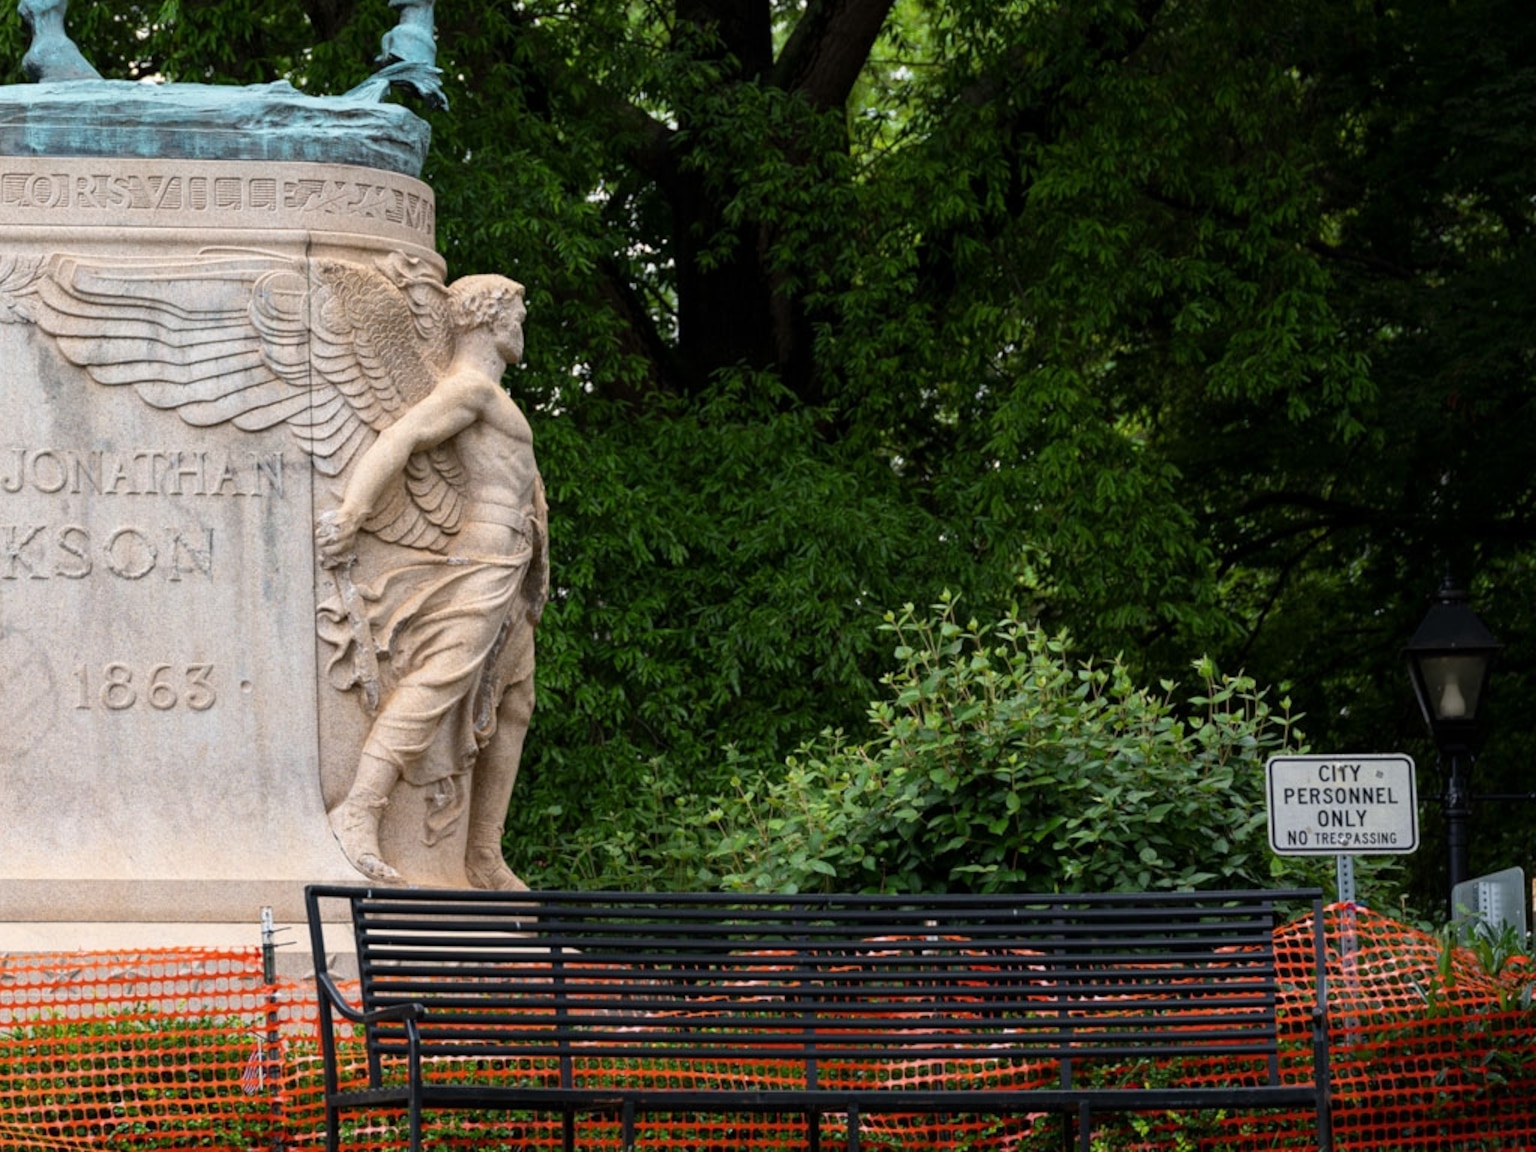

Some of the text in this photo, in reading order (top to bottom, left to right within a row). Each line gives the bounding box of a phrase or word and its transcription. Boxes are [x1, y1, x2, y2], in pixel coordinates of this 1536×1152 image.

[0, 448, 284, 499] JONATHAN
[72, 662, 218, 711] 1863
[1318, 764, 1361, 782] CITY
[1284, 787, 1398, 805] PERSONNEL
[1318, 810, 1367, 827] ONLY
[1288, 830, 1397, 845] NO TRESPASSING
